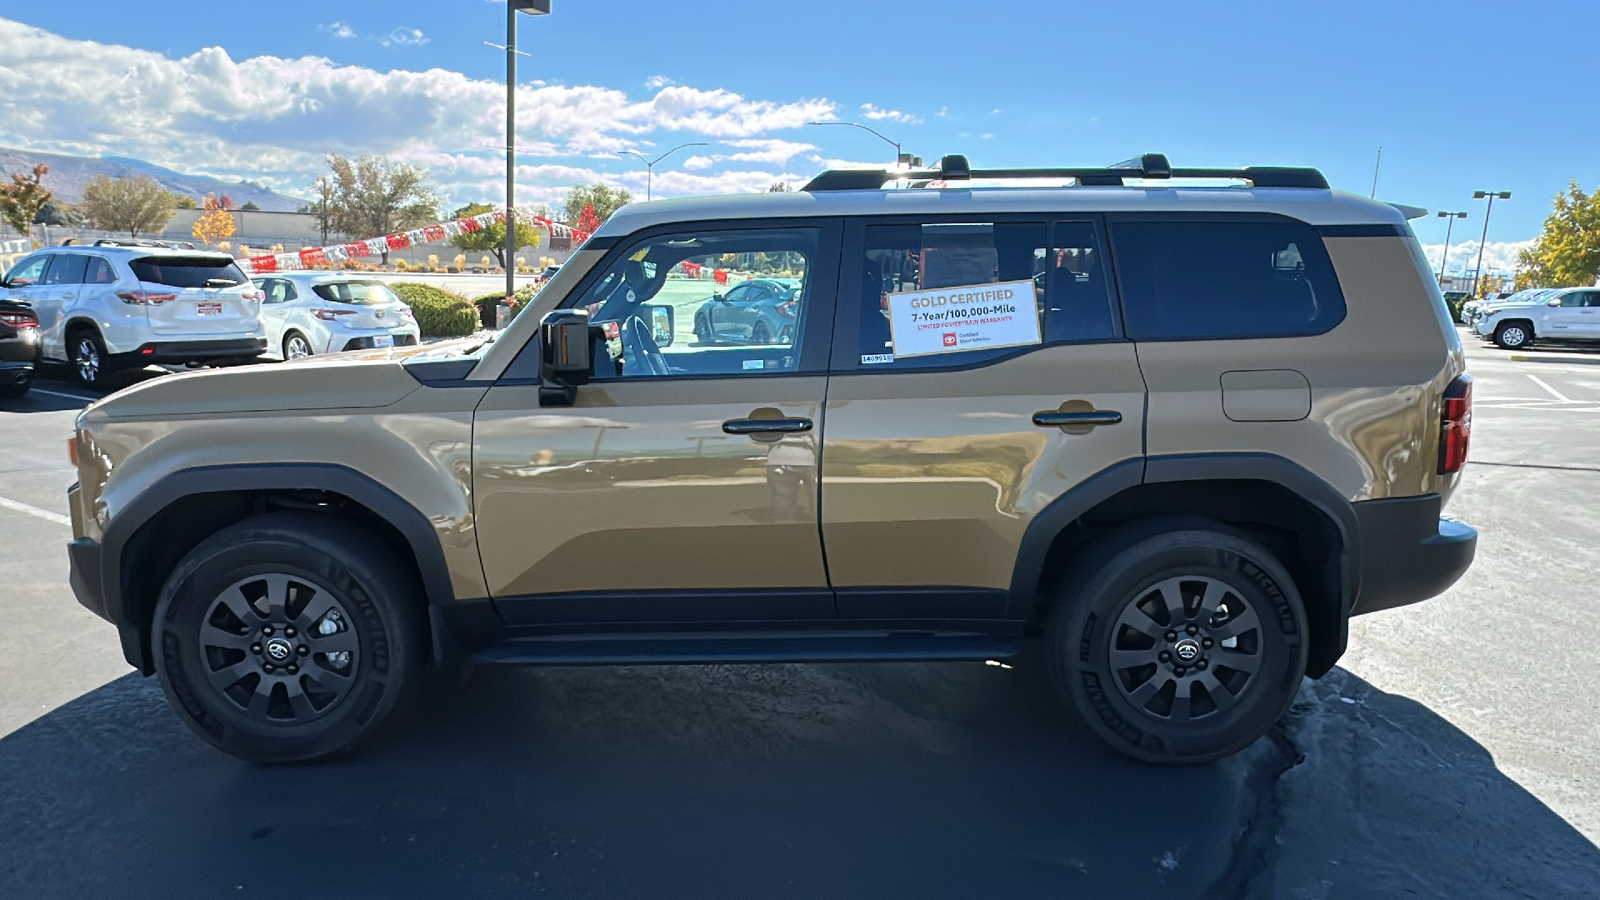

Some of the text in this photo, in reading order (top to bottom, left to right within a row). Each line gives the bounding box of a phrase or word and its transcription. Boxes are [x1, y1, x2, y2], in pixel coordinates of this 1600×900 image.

[910, 289, 1014, 309] GOLD CERTIFIED
[911, 305, 1016, 322] 7-Year/100,000-Mile
[941, 319, 979, 328] POWERTRAIN
[980, 316, 1012, 325] WARRANTY
